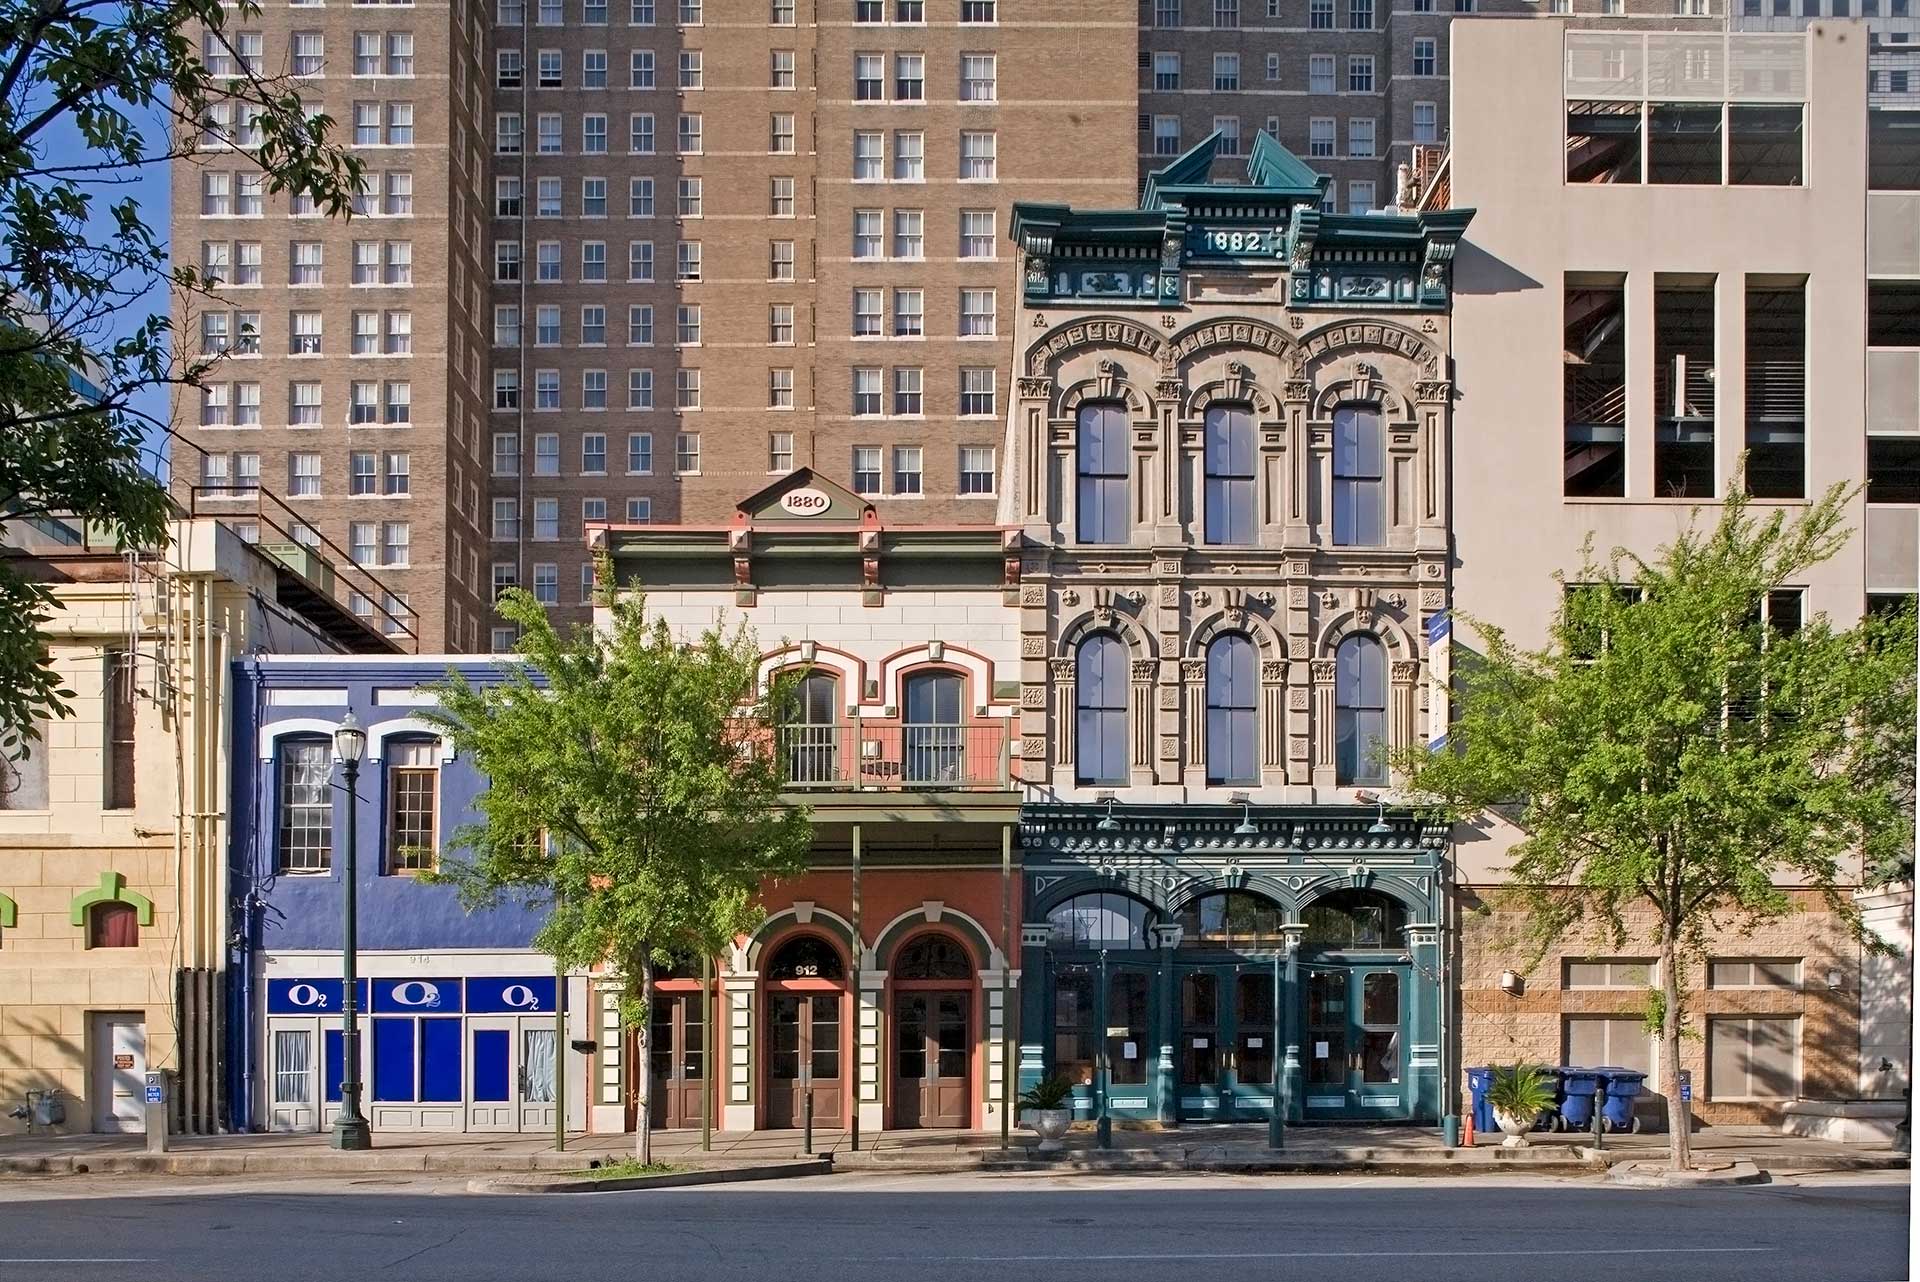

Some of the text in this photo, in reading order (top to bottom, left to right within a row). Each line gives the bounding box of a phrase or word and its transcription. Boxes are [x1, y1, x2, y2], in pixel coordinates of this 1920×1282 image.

[786, 495, 825, 508] 1880
[795, 965, 818, 976] 912
[288, 984, 328, 1008] O2
[391, 981, 441, 1008] O2
[502, 984, 539, 1011] O2
